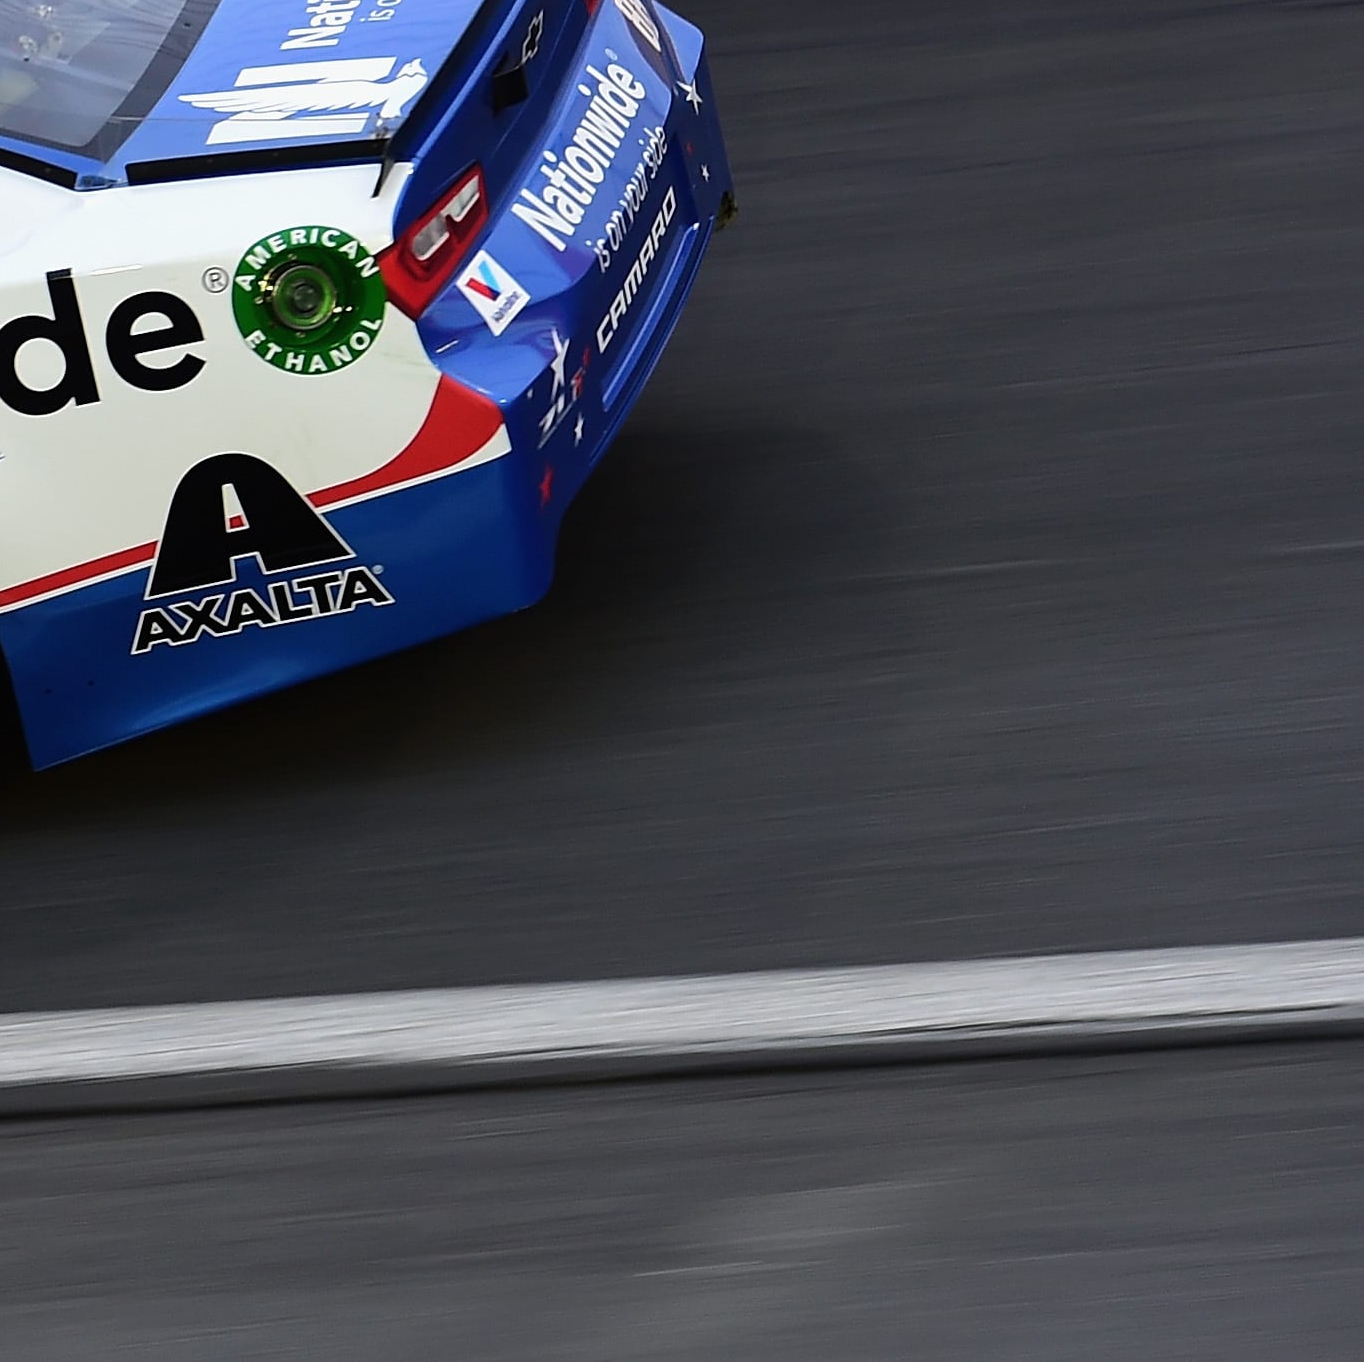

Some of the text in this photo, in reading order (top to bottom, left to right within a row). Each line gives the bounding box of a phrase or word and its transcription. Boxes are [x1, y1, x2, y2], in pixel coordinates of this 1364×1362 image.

[360, 9, 395, 22] is
[511, 64, 646, 252] Nationwide
[586, 125, 669, 274] is on your side
[233, 227, 380, 295] AMERICAN
[595, 186, 678, 355] CAMARO
[243, 316, 384, 373] ETHANOL
[130, 565, 395, 656] AXALTA
